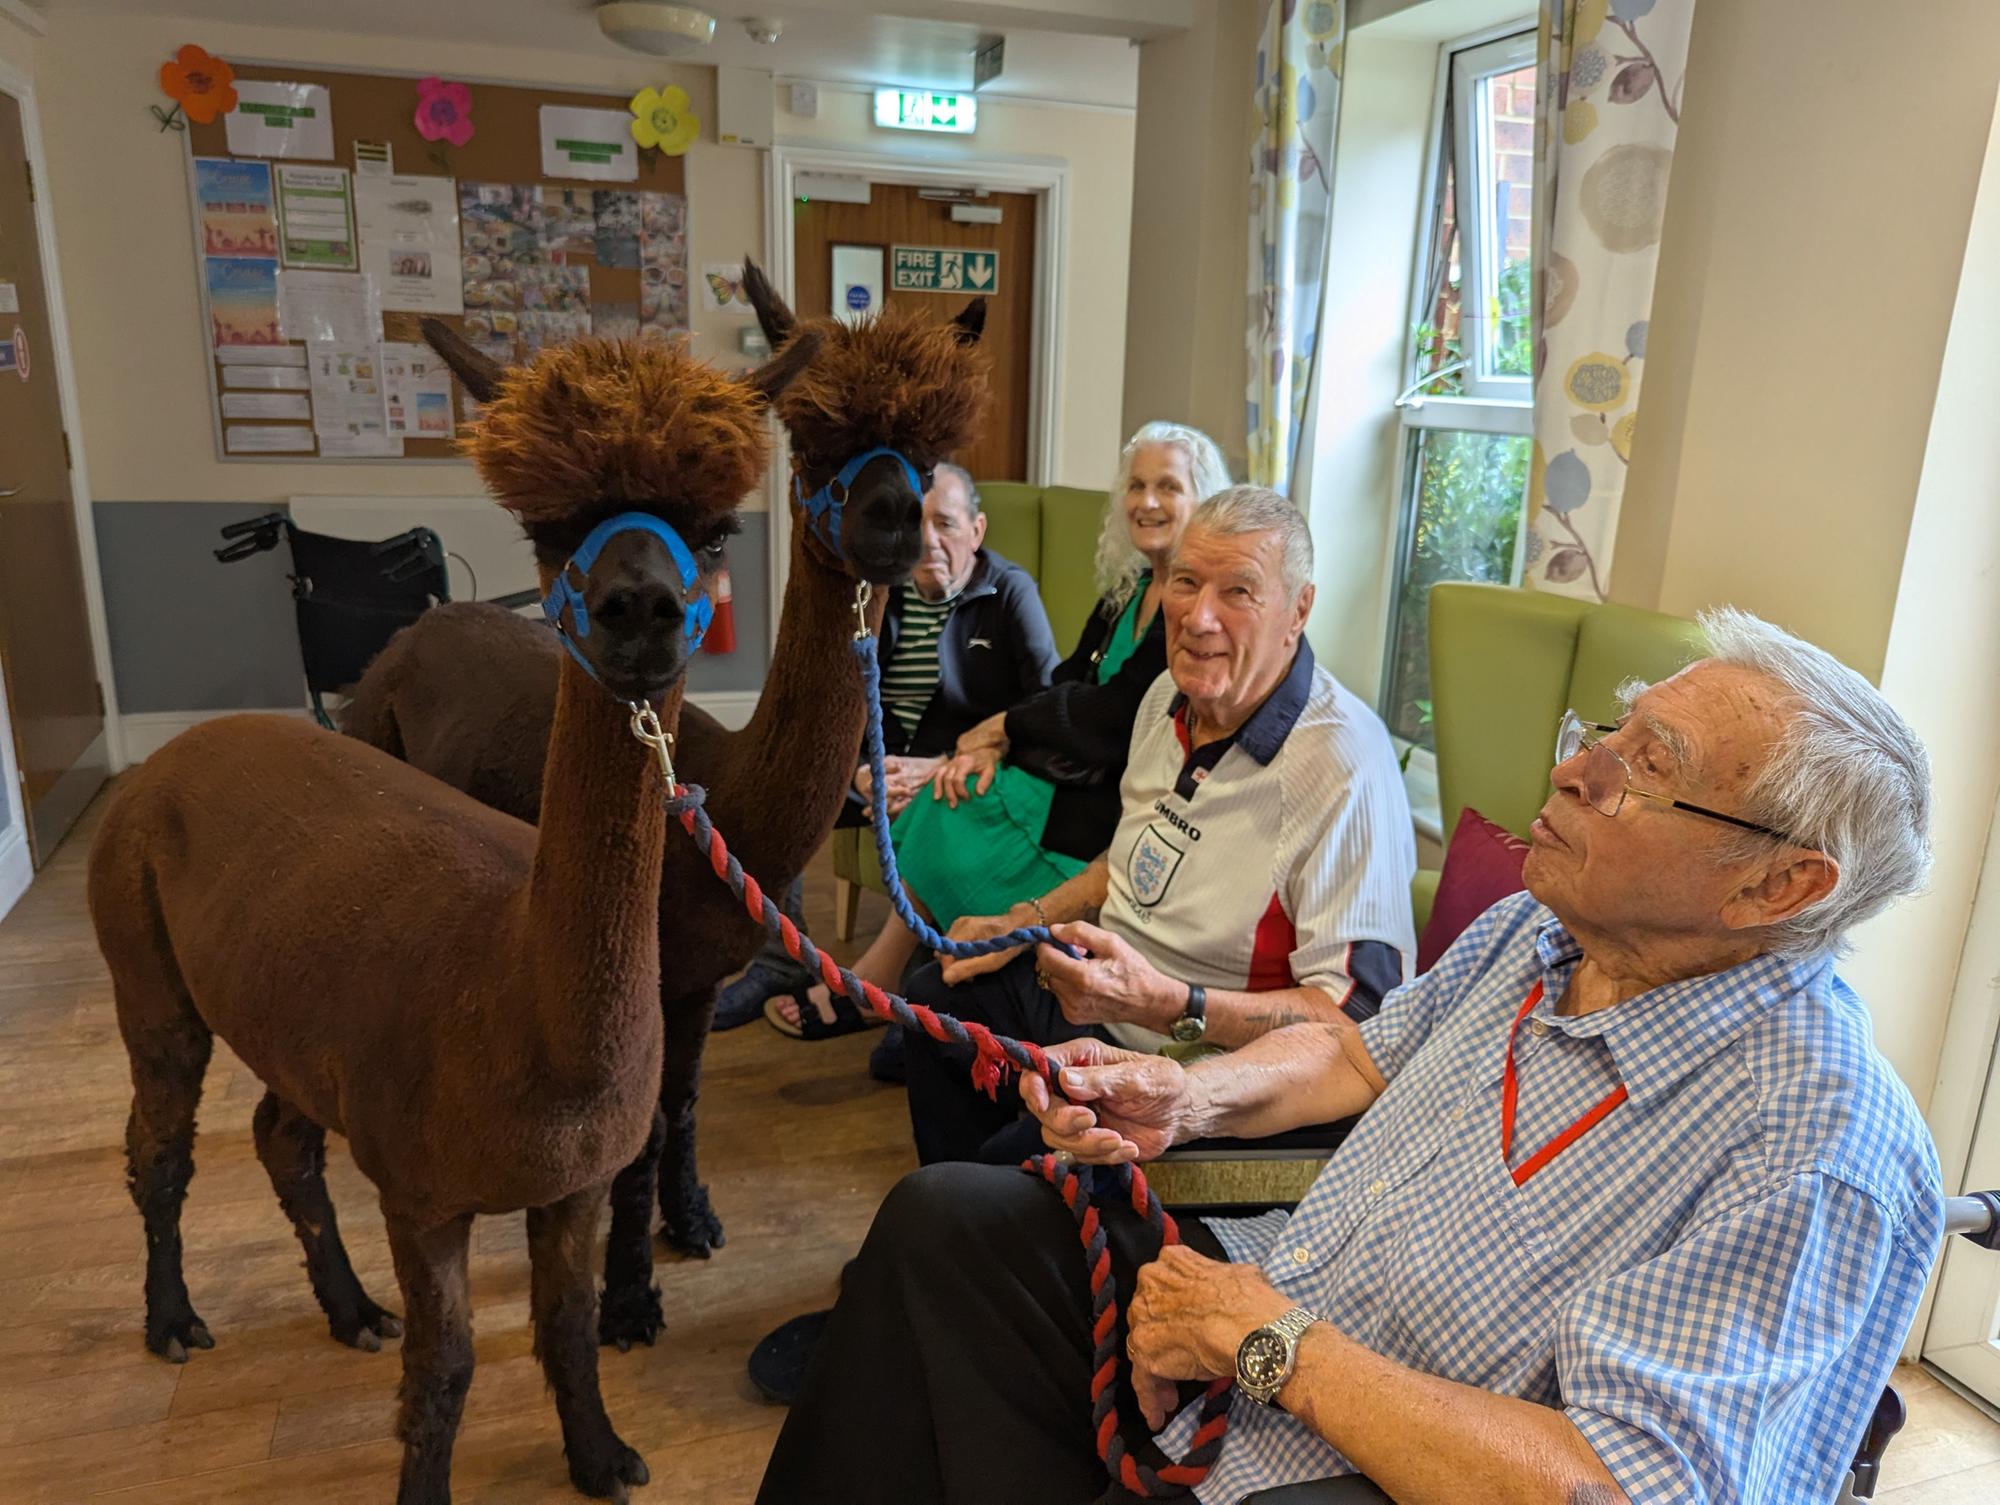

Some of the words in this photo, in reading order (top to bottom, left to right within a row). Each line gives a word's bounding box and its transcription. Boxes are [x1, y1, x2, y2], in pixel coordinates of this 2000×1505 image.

[896, 251, 936, 268] FIRE
[898, 271, 936, 287] EXIT
[1154, 800, 1201, 841] UMBRO
